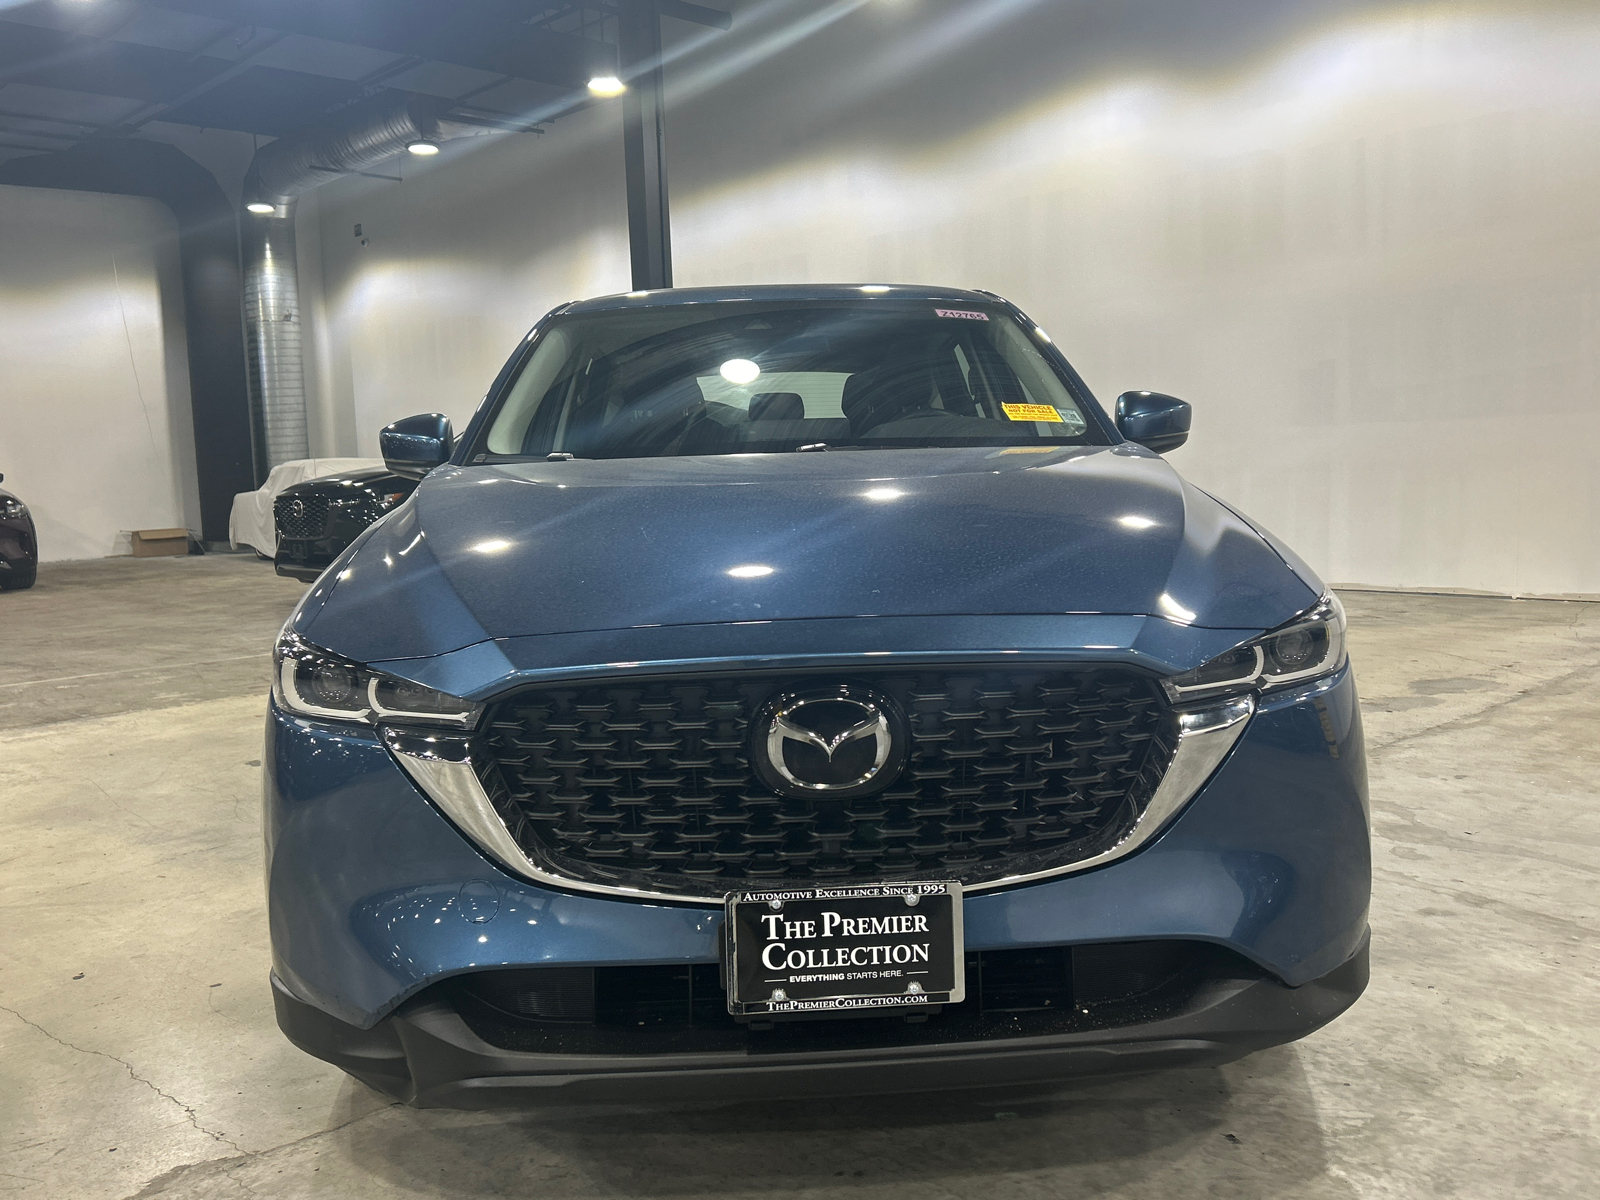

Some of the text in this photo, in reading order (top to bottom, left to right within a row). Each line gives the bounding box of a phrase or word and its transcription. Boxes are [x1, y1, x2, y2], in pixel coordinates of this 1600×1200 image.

[743, 890, 812, 902] AUTOMOTIVE
[815, 888, 880, 898] EXCELLENCE
[917, 884, 946, 895] 1995
[761, 911, 930, 941] THE PREMIER
[761, 942, 931, 971] COLLECTION
[789, 970, 904, 983] EVERYTHING STARTS HERE.
